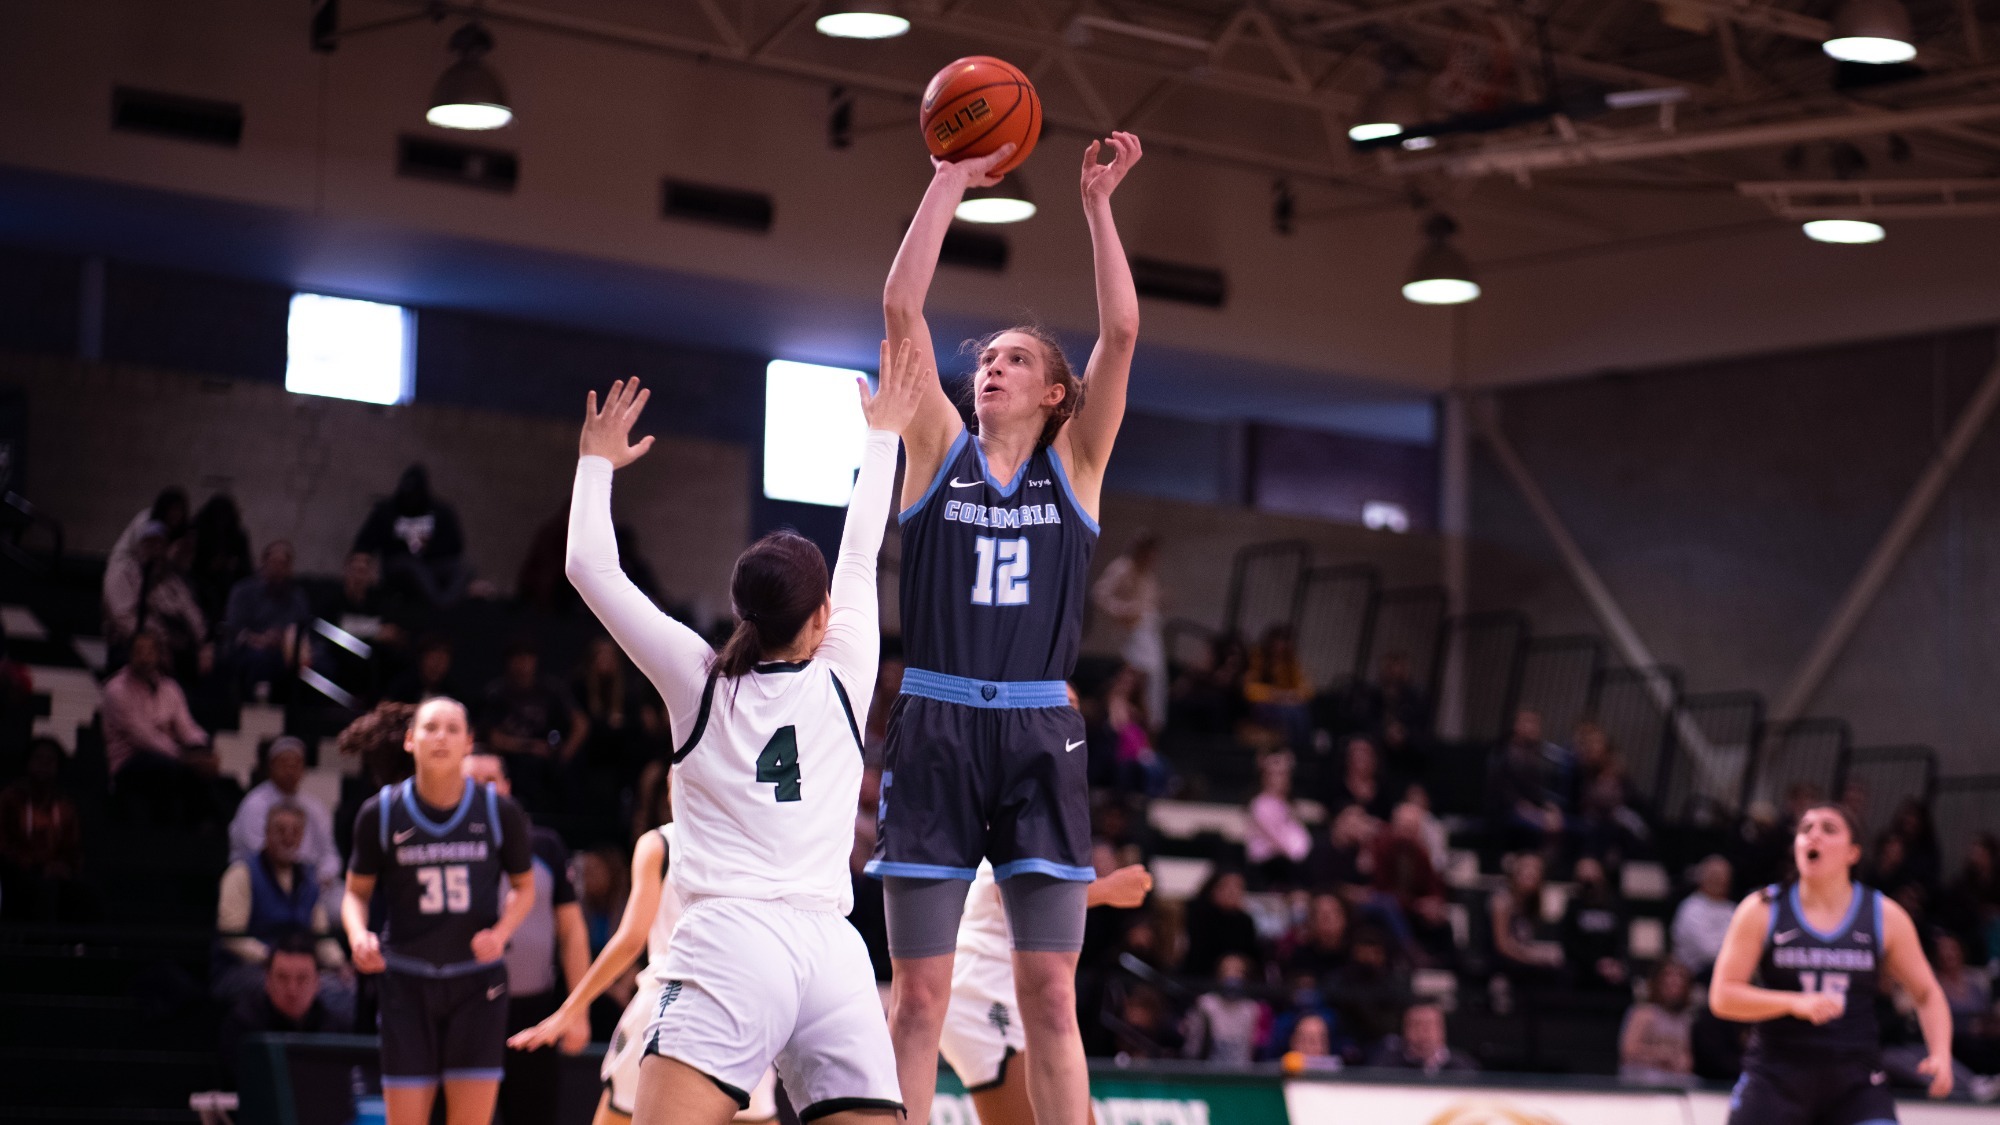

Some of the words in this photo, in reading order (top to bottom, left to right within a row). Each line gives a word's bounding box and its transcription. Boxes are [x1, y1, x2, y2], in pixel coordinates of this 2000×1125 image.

[933, 97, 991, 142] ELITE
[944, 500, 1061, 529] COLUMBIA
[970, 535, 1030, 606] 12
[756, 725, 802, 802] 4
[416, 865, 471, 915] 35
